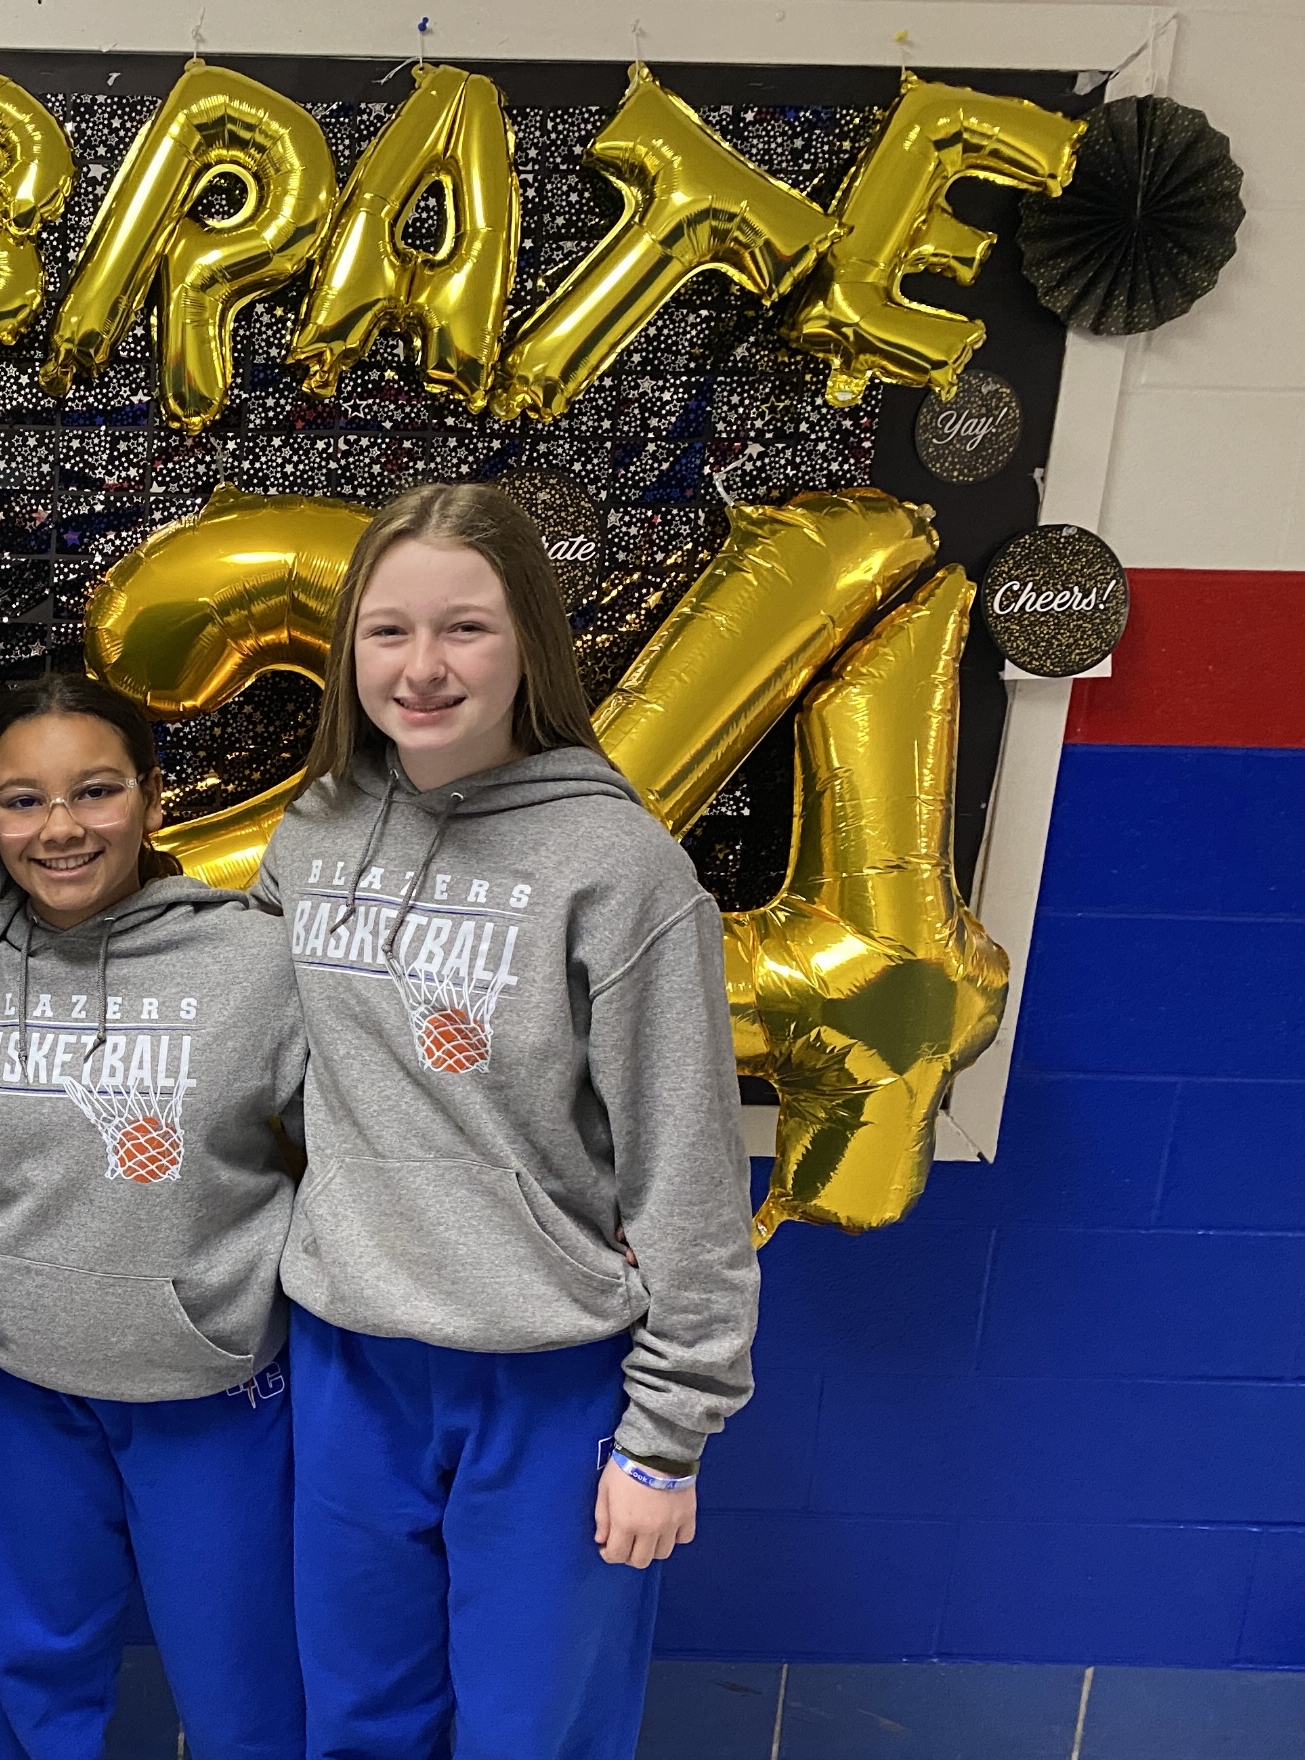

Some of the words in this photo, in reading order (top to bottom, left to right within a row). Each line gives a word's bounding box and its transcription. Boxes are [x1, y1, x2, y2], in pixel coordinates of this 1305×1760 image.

[931, 406, 1008, 451] Yay!
[992, 579, 1117, 615] Cheers!
[291, 900, 519, 987] BASKETBALL
